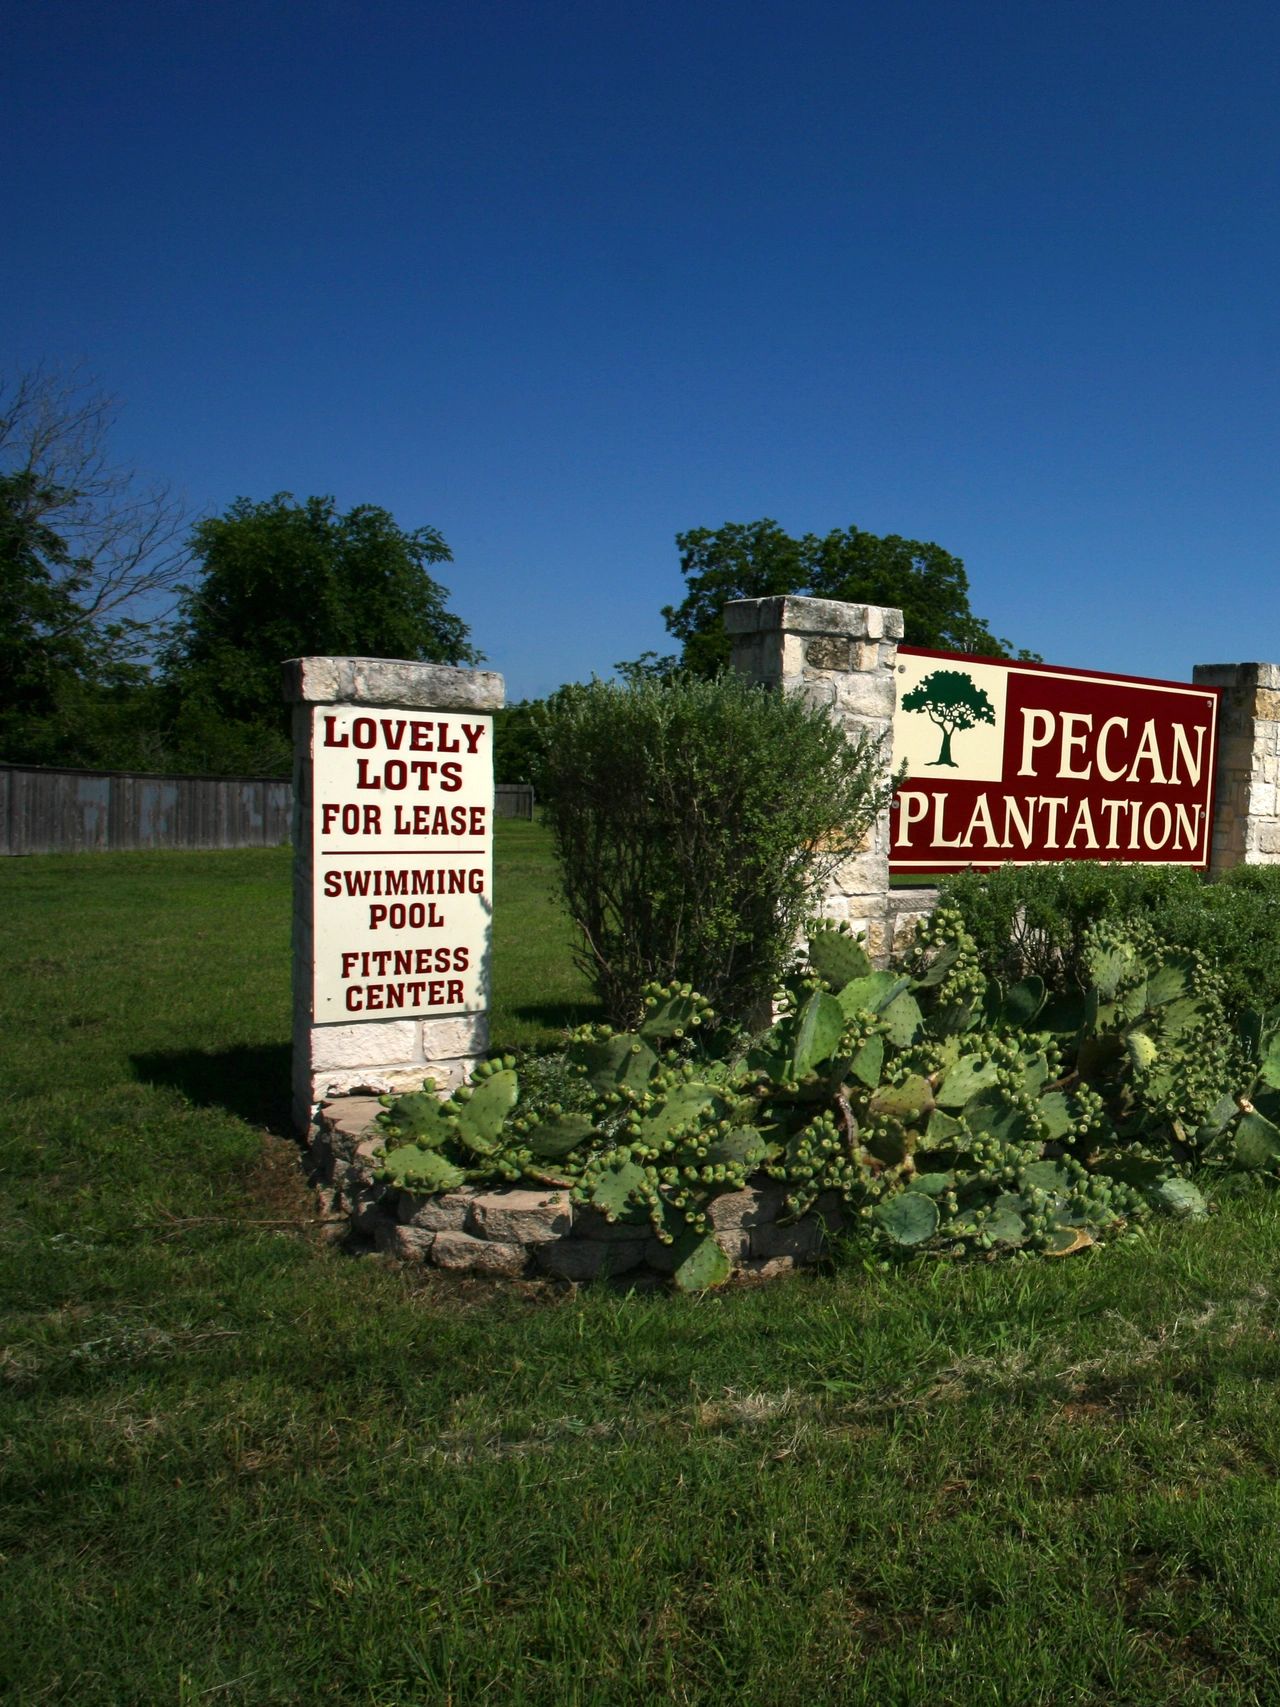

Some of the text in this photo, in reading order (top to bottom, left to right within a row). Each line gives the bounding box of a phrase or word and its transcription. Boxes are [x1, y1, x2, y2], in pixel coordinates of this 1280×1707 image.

[323, 716, 485, 754] LOVELY
[1017, 707, 1207, 788] PECAN
[356, 759, 462, 792] LOTS
[322, 803, 485, 836] FOR LEASE
[894, 791, 1202, 851] PLANTATION
[324, 868, 484, 897] SWIMMING
[369, 903, 444, 929] POOL
[341, 947, 469, 979] FITNESS
[345, 979, 464, 1012] CENTER
